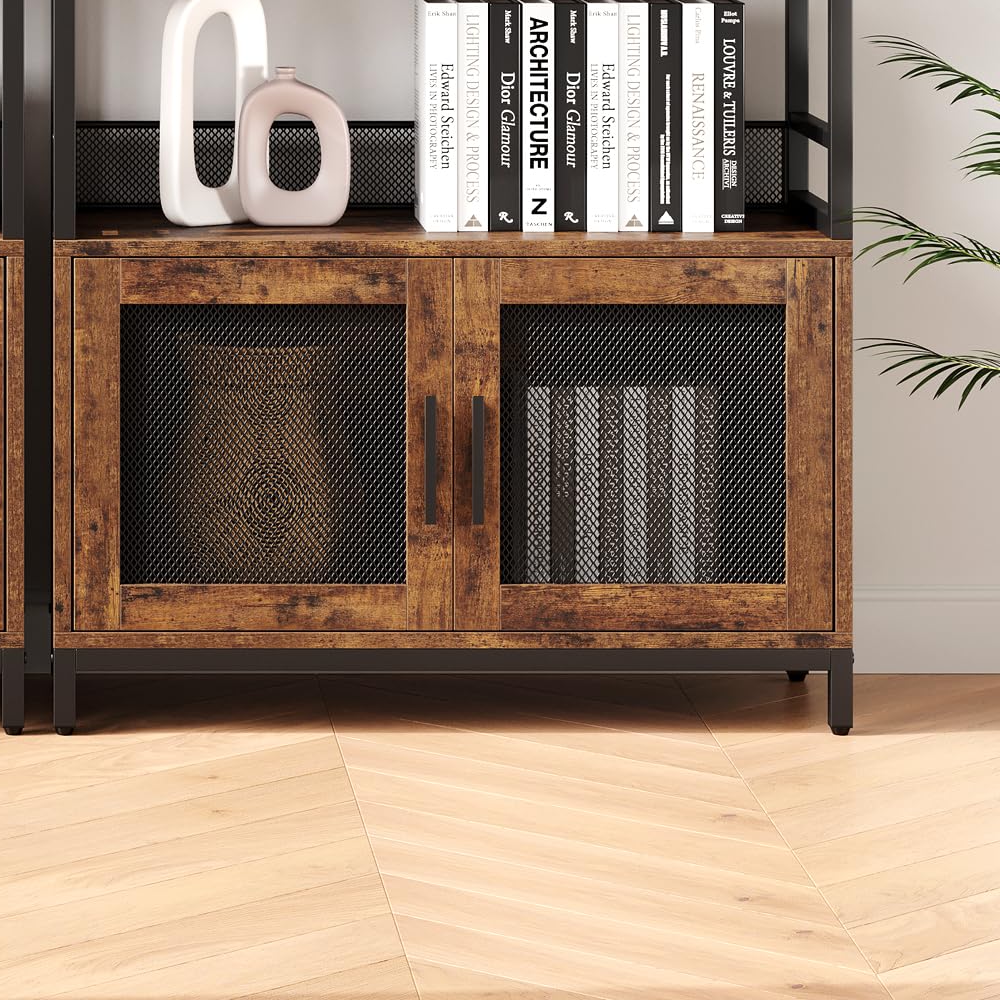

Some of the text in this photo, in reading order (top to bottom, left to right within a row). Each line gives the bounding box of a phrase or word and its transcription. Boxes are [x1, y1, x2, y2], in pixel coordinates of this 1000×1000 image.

[429, 64, 437, 88] LIVES
[429, 91, 437, 101] IN
[441, 64, 454, 169] Edward Steichen
[466, 14, 480, 203] LIGHTING DESIGN & PROCESS
[500, 72, 515, 168] Dior Glamour
[530, 17, 548, 169] ARCHITECTURE
[566, 72, 581, 168] Dior Glamour
[590, 64, 598, 88] LIVES
[590, 91, 598, 101] IN
[602, 64, 615, 169] Edward Steichen
[627, 14, 641, 203] LIGHTING DESIGN & PROCESS
[692, 73, 704, 180] RENAISSANCE
[723, 38, 736, 156] LOUVRE & TUILERIS
